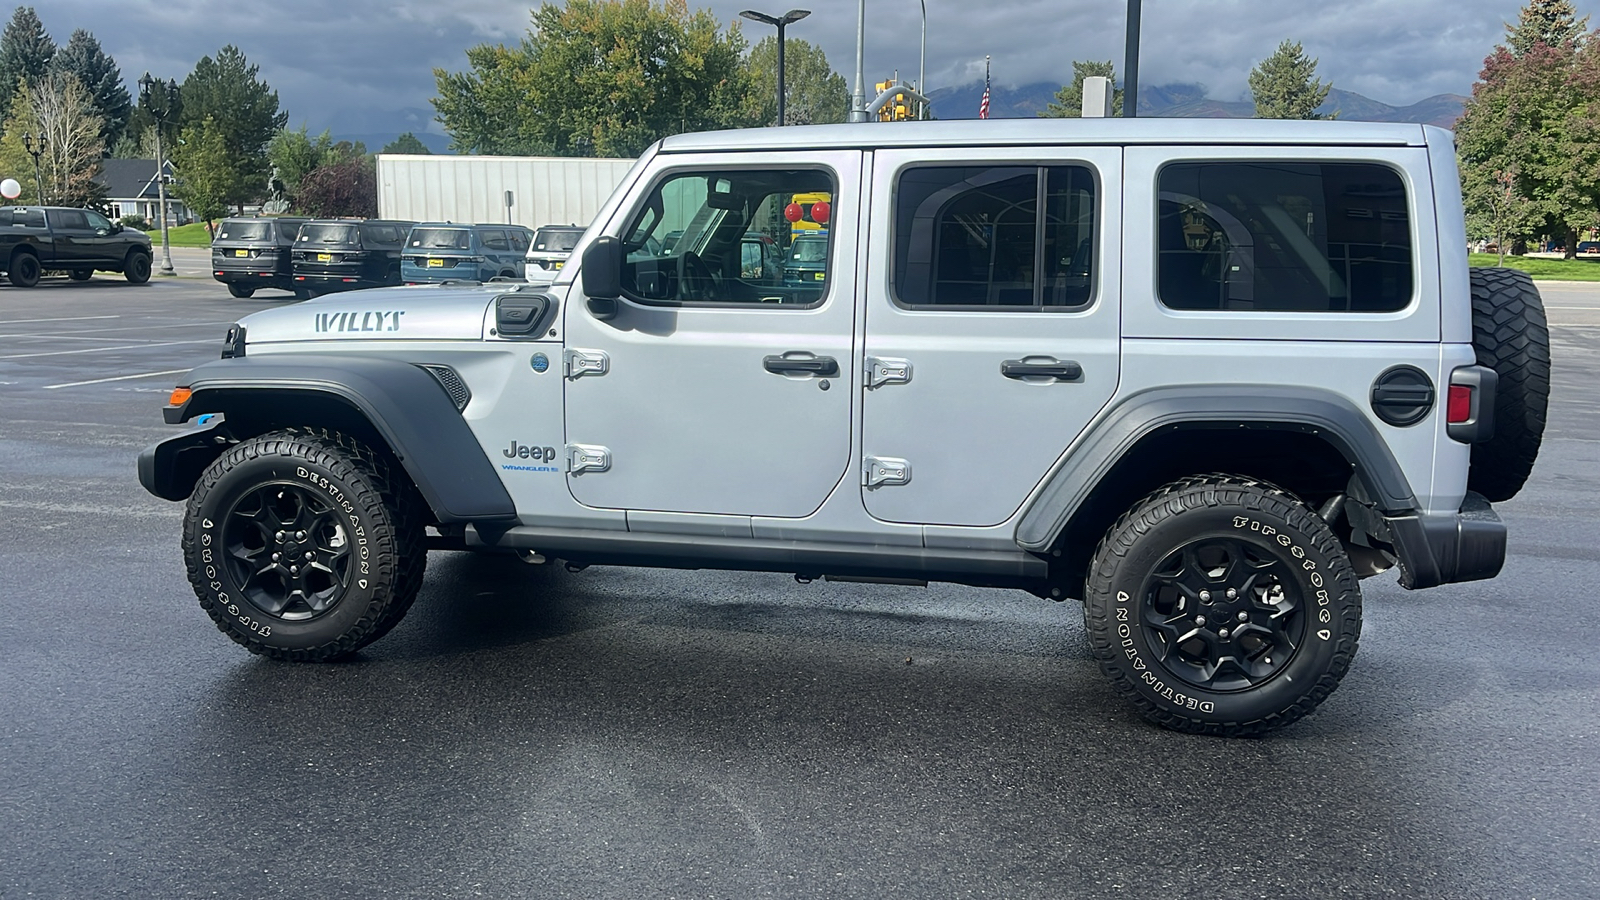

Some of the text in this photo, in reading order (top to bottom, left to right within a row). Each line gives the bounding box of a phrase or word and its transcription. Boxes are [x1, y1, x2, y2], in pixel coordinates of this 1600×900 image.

[315, 310, 406, 333] WILLYS
[502, 440, 556, 463] Jeep
[501, 464, 550, 472] WRANGLER
[296, 466, 370, 575] DESTINATION
[1116, 607, 1215, 714] DESTINATION
